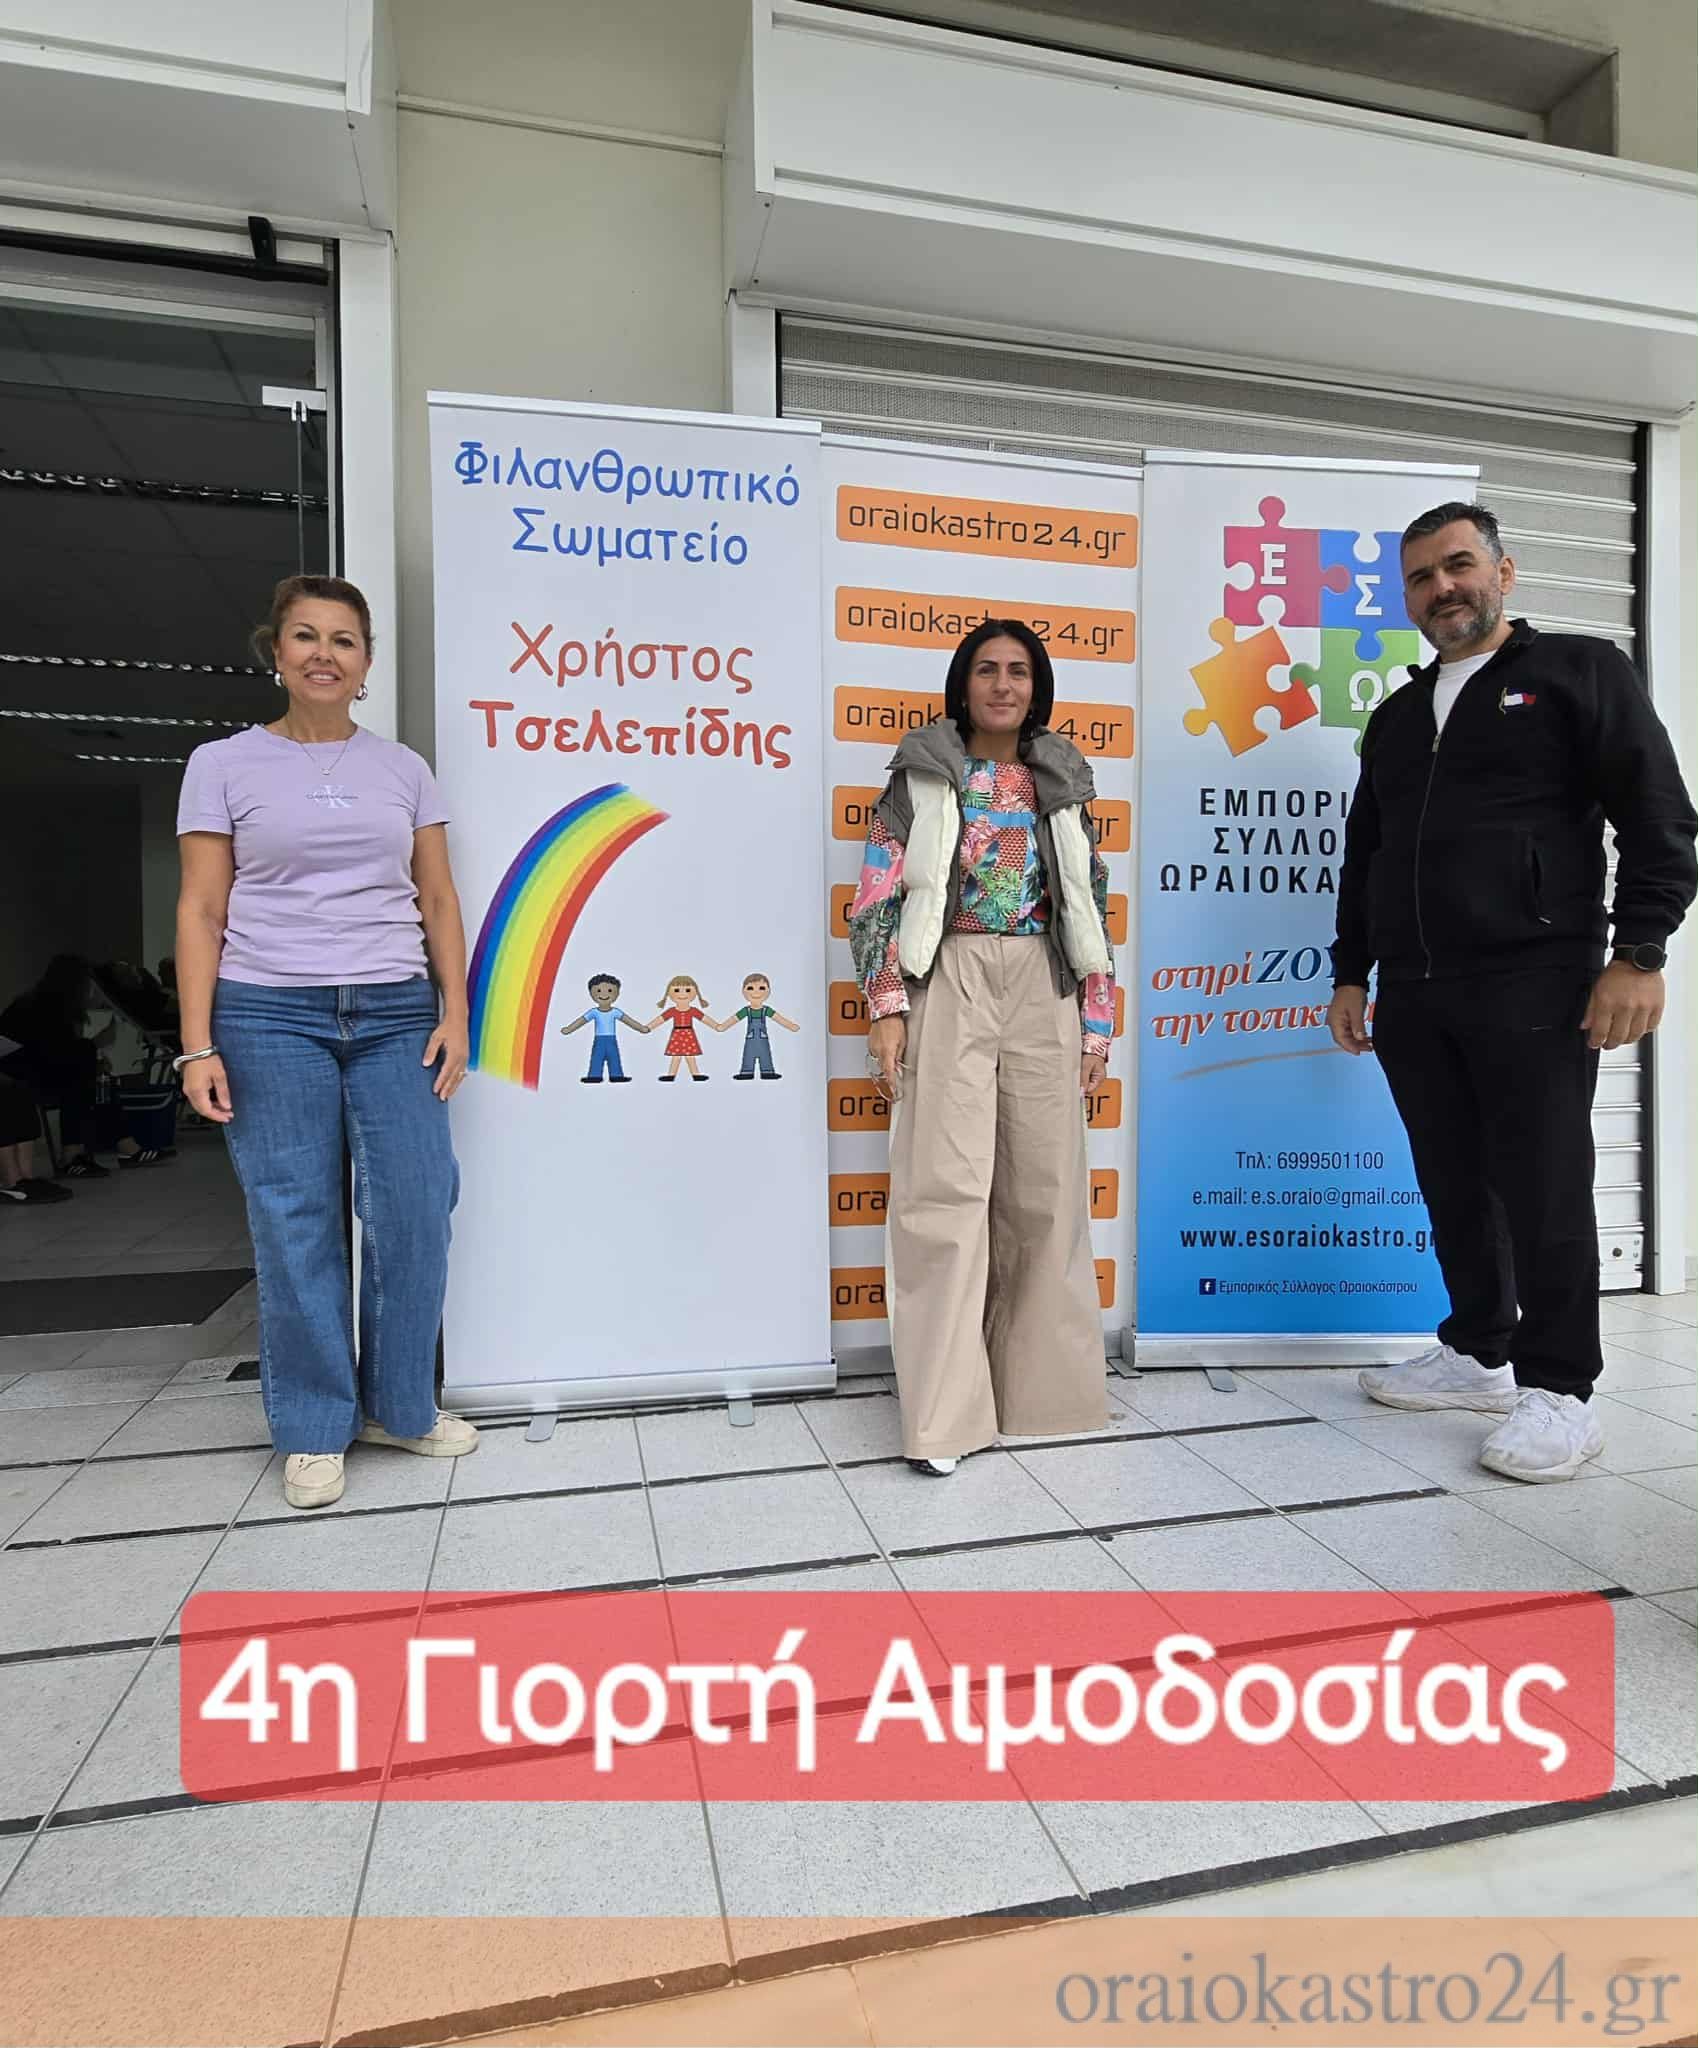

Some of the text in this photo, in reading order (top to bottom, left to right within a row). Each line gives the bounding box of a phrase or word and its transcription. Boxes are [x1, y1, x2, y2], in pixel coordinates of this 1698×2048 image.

[454, 441, 801, 506] Φιλανθρωπικό
[512, 507, 749, 567] Σωματείο
[848, 503, 1127, 559] oraiokastro24.gr
[1355, 574, 1383, 616] Σ
[847, 602, 1125, 656] oraiokas24.gr
[510, 621, 754, 695] Χρήστος
[1349, 670, 1385, 712] Ω
[469, 700, 793, 770] Τσελεπίδης
[1200, 788, 1347, 818] ΕΜΠΟΡΙ
[1213, 827, 1337, 856] ΣΥΛΛΟ
[1160, 864, 1335, 894] ΩΡΑΙΟΚΑ
[1152, 1011, 1214, 1046] την
[1277, 1151, 1384, 1170] 6999501100
[1192, 1187, 1247, 1205] e.mail:
[1219, 1280, 1279, 1295] Εμπορικός
[1282, 1280, 1336, 1295] Σύλλογος
[1339, 1280, 1418, 1295] Ωραιοκάστρου
